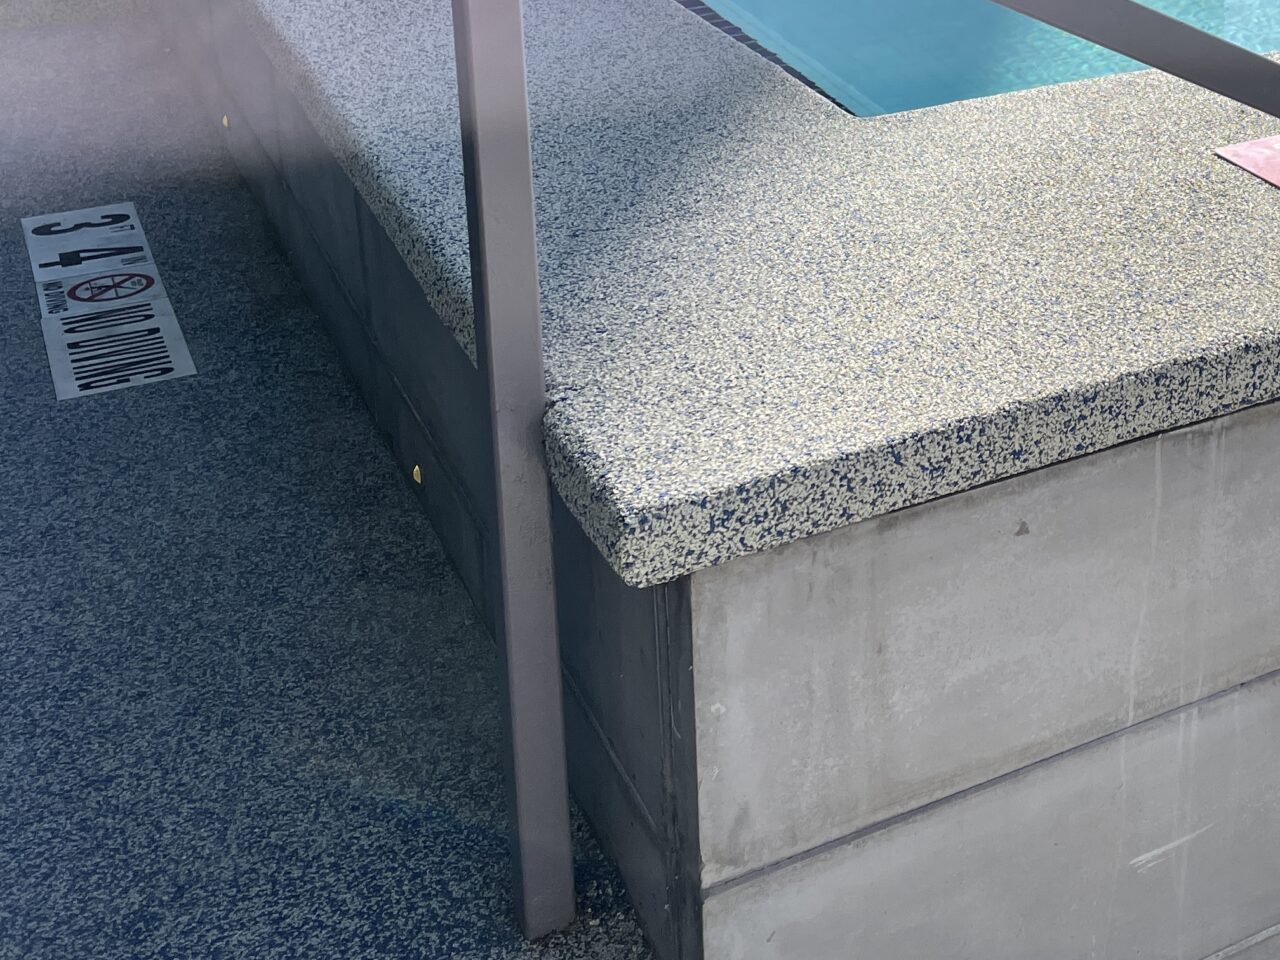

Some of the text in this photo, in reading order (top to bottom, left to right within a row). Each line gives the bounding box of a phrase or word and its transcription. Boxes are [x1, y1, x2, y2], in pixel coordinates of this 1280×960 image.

[31, 213, 131, 236] 3
[38, 245, 144, 268] 4
[42, 280, 69, 314] NO DIVING
[60, 303, 175, 392] NO DIVING
